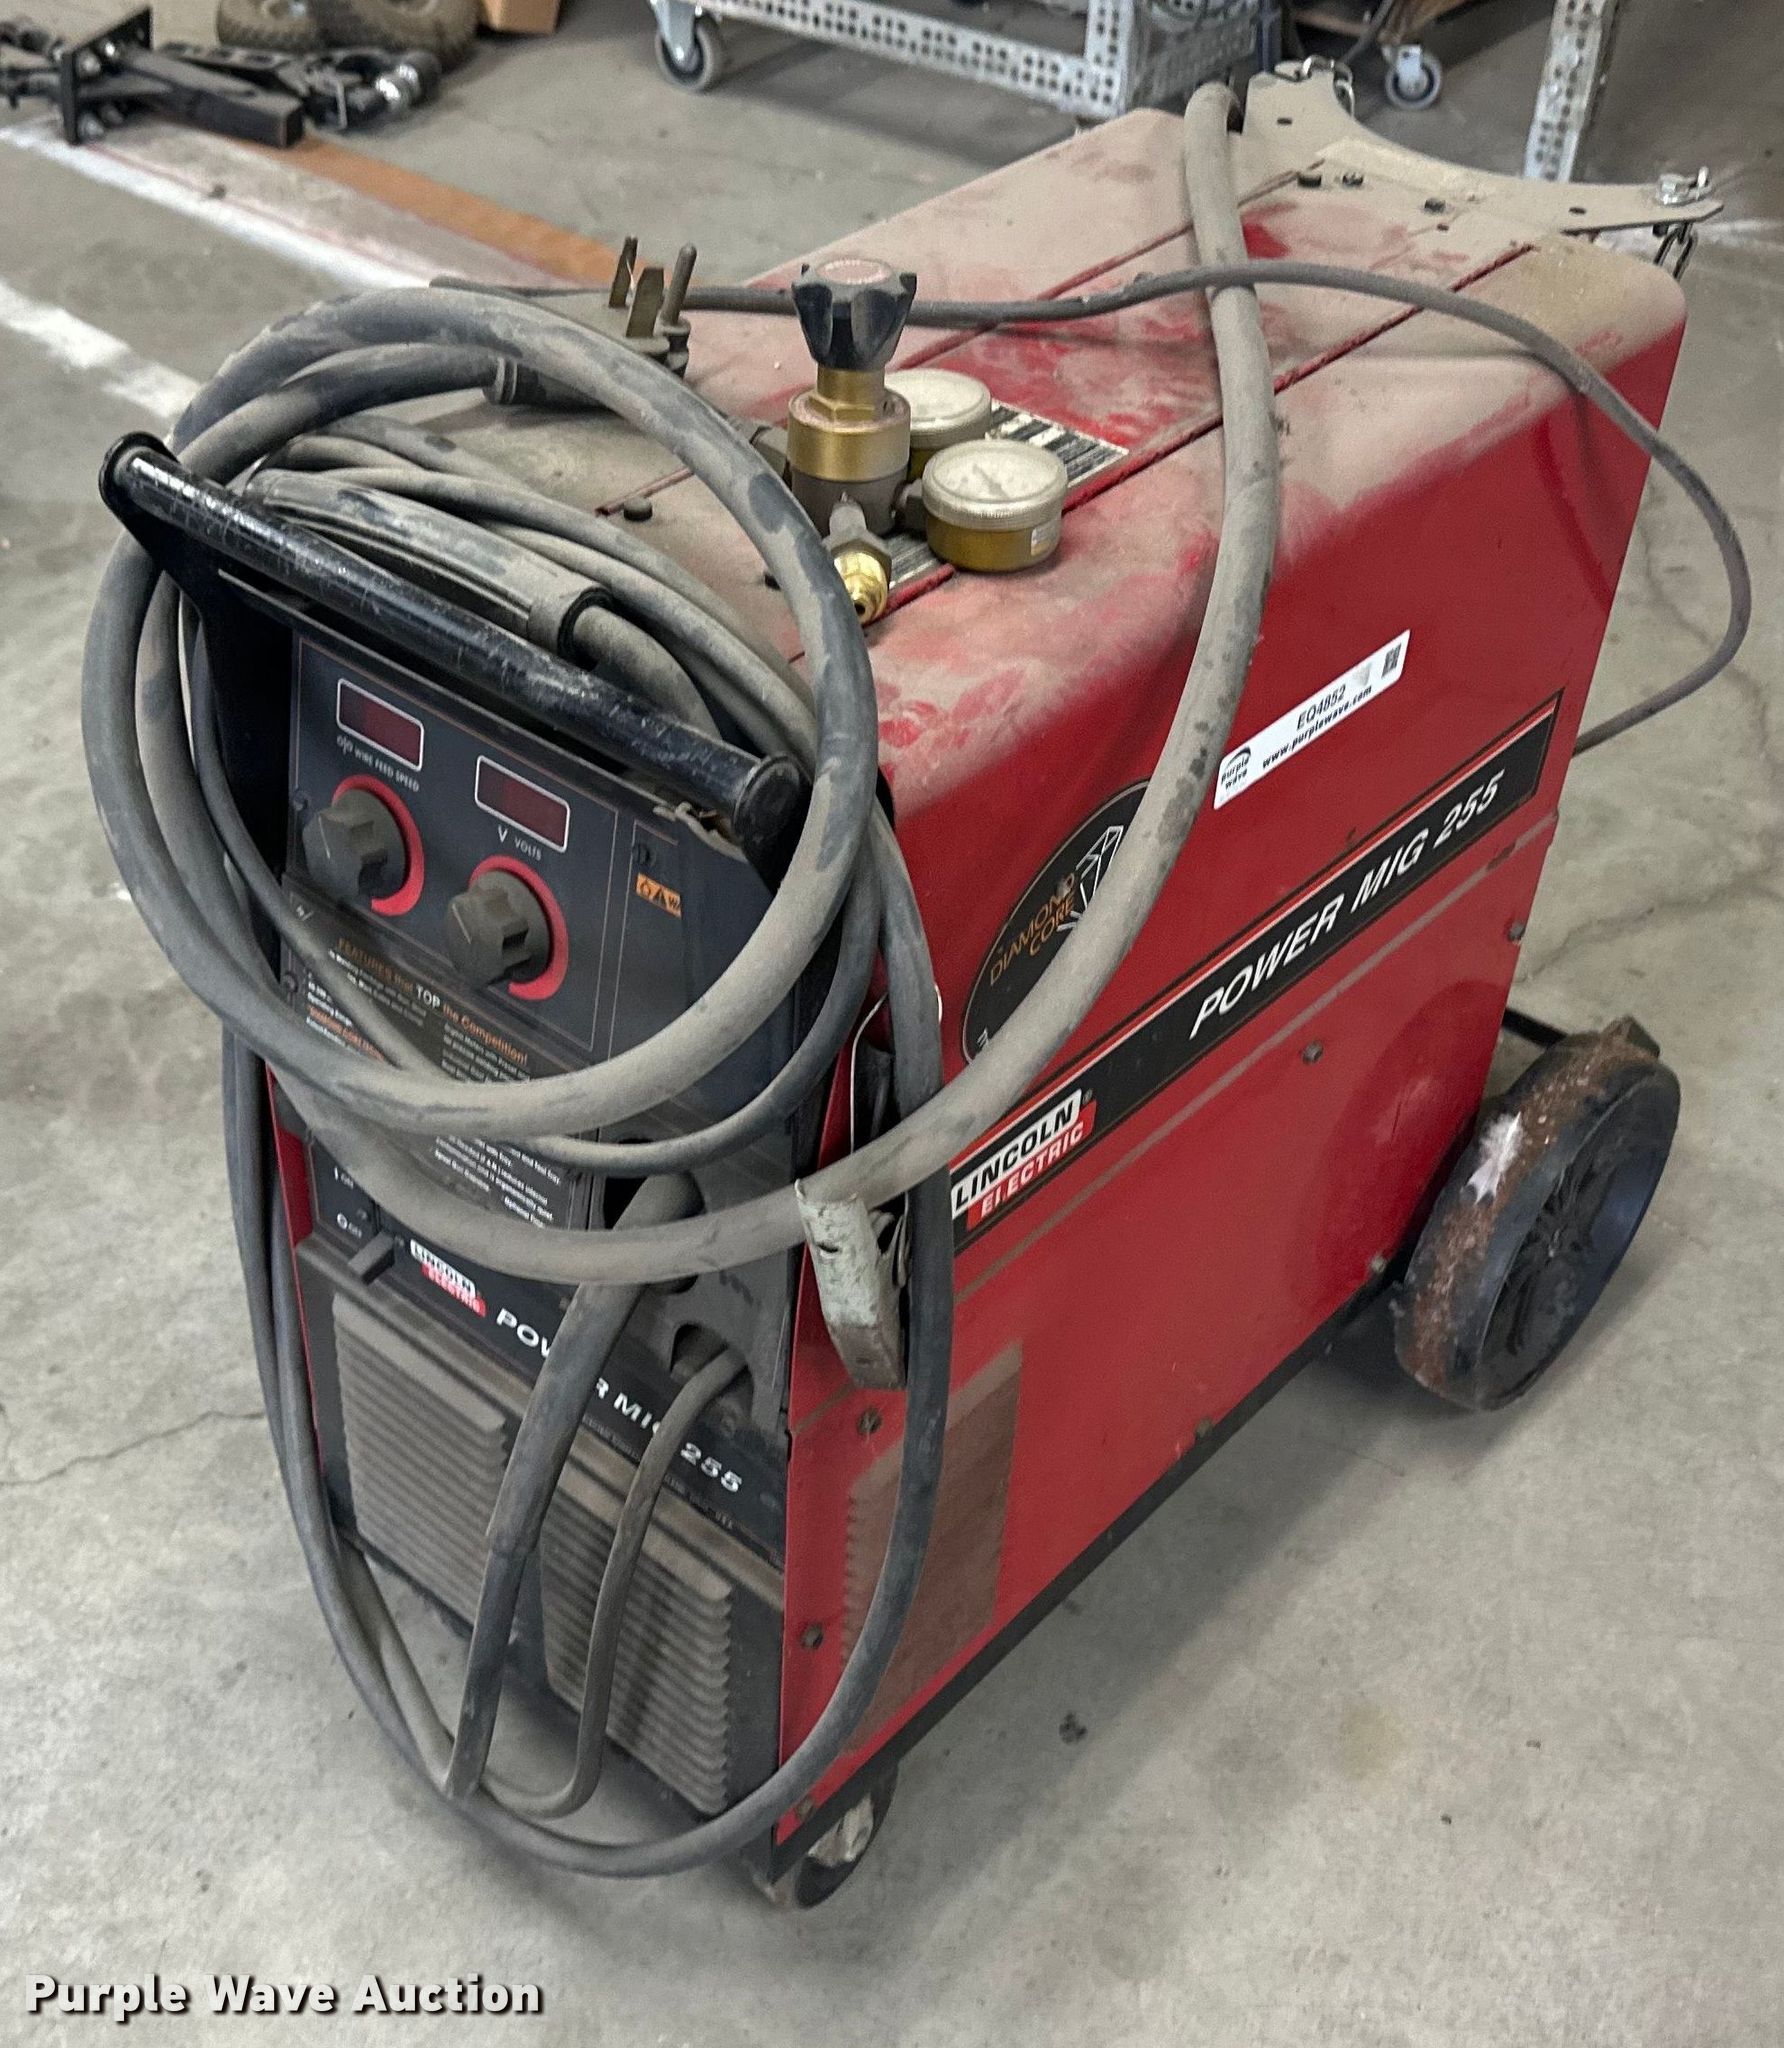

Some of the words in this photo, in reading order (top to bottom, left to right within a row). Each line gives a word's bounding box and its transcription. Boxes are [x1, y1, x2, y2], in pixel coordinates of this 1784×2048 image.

[1262, 685, 1373, 770] www.purplewave.com
[1296, 683, 1347, 731] EQ4852
[395, 769, 420, 793] SPEED
[1220, 757, 1250, 784] purple
[514, 836, 542, 861] VOLTS
[1029, 892, 1076, 957] CORE
[1189, 893, 1345, 1041] POWER
[1350, 828, 1429, 914] MIG
[1433, 768, 1505, 849] 255
[415, 984, 441, 1008] TOP
[442, 1003, 460, 1024] the
[955, 1099, 1075, 1211] LINCOLN
[680, 1442, 743, 1493] 255
